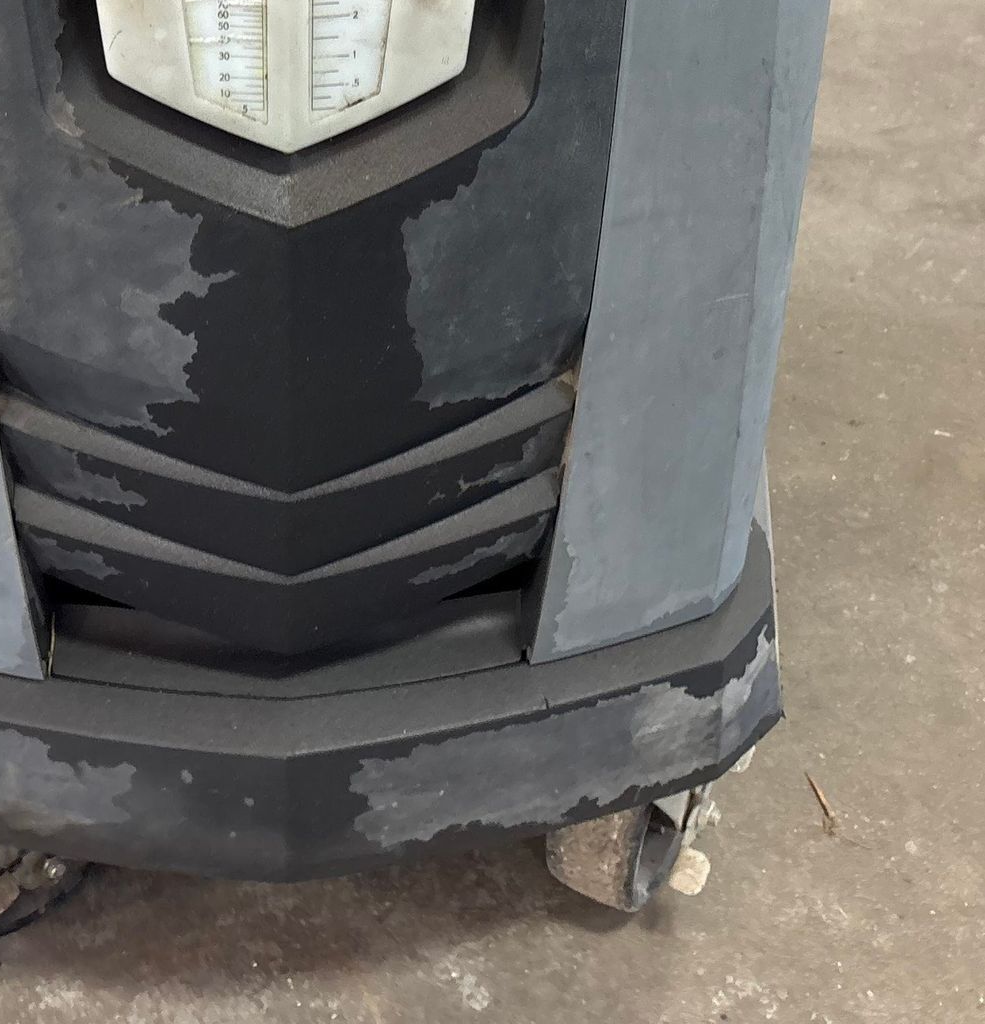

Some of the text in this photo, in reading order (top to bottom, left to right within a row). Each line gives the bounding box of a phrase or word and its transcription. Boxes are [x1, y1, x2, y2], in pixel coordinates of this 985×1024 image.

[218, 11, 229, 19] 60
[353, 11, 358, 19] 2
[218, 21, 229, 30] 50
[219, 52, 230, 60] 30
[353, 50, 356, 59] 1
[219, 73, 230, 82] 20
[352, 79, 359, 87] .5
[221, 89, 230, 97] 10
[243, 104, 248, 113] 5
